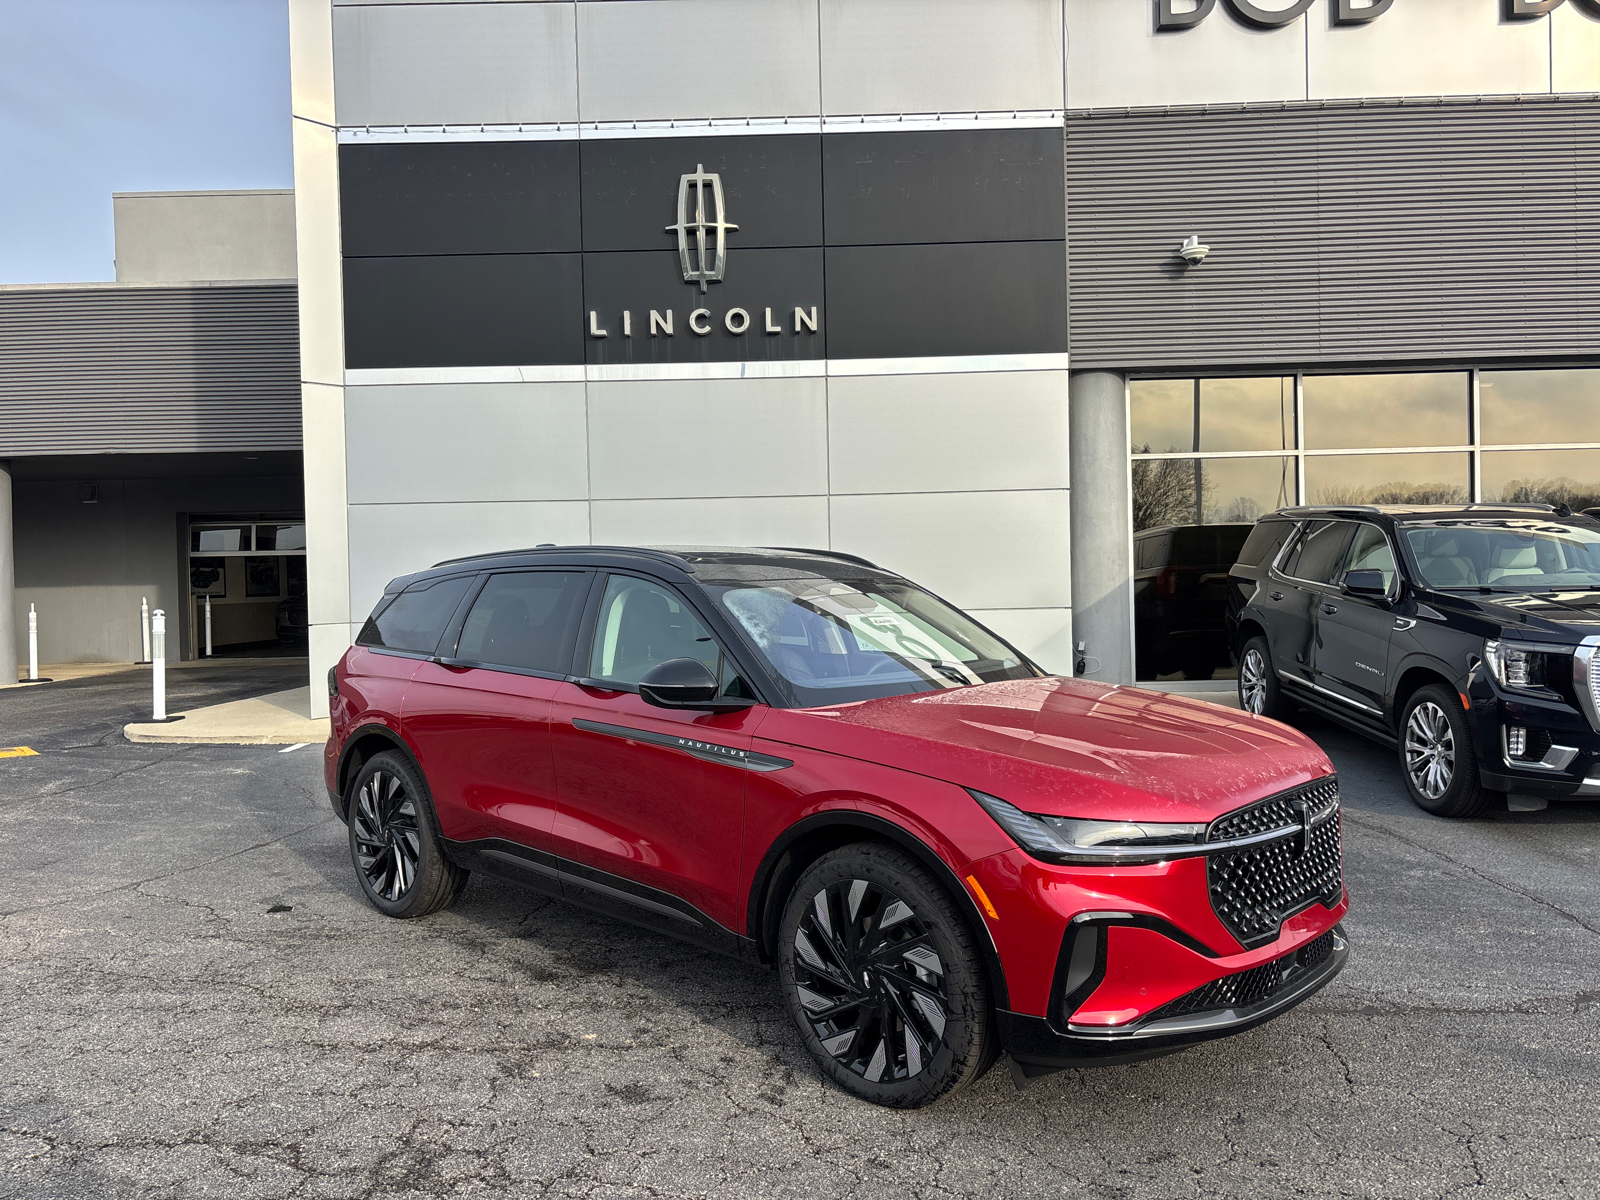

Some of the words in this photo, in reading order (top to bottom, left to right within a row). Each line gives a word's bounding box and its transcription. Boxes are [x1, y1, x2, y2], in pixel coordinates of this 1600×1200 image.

[590, 307, 818, 338] LINCOLN
[1355, 661, 1385, 677] DENALI
[679, 739, 745, 757] NAUTILUS
